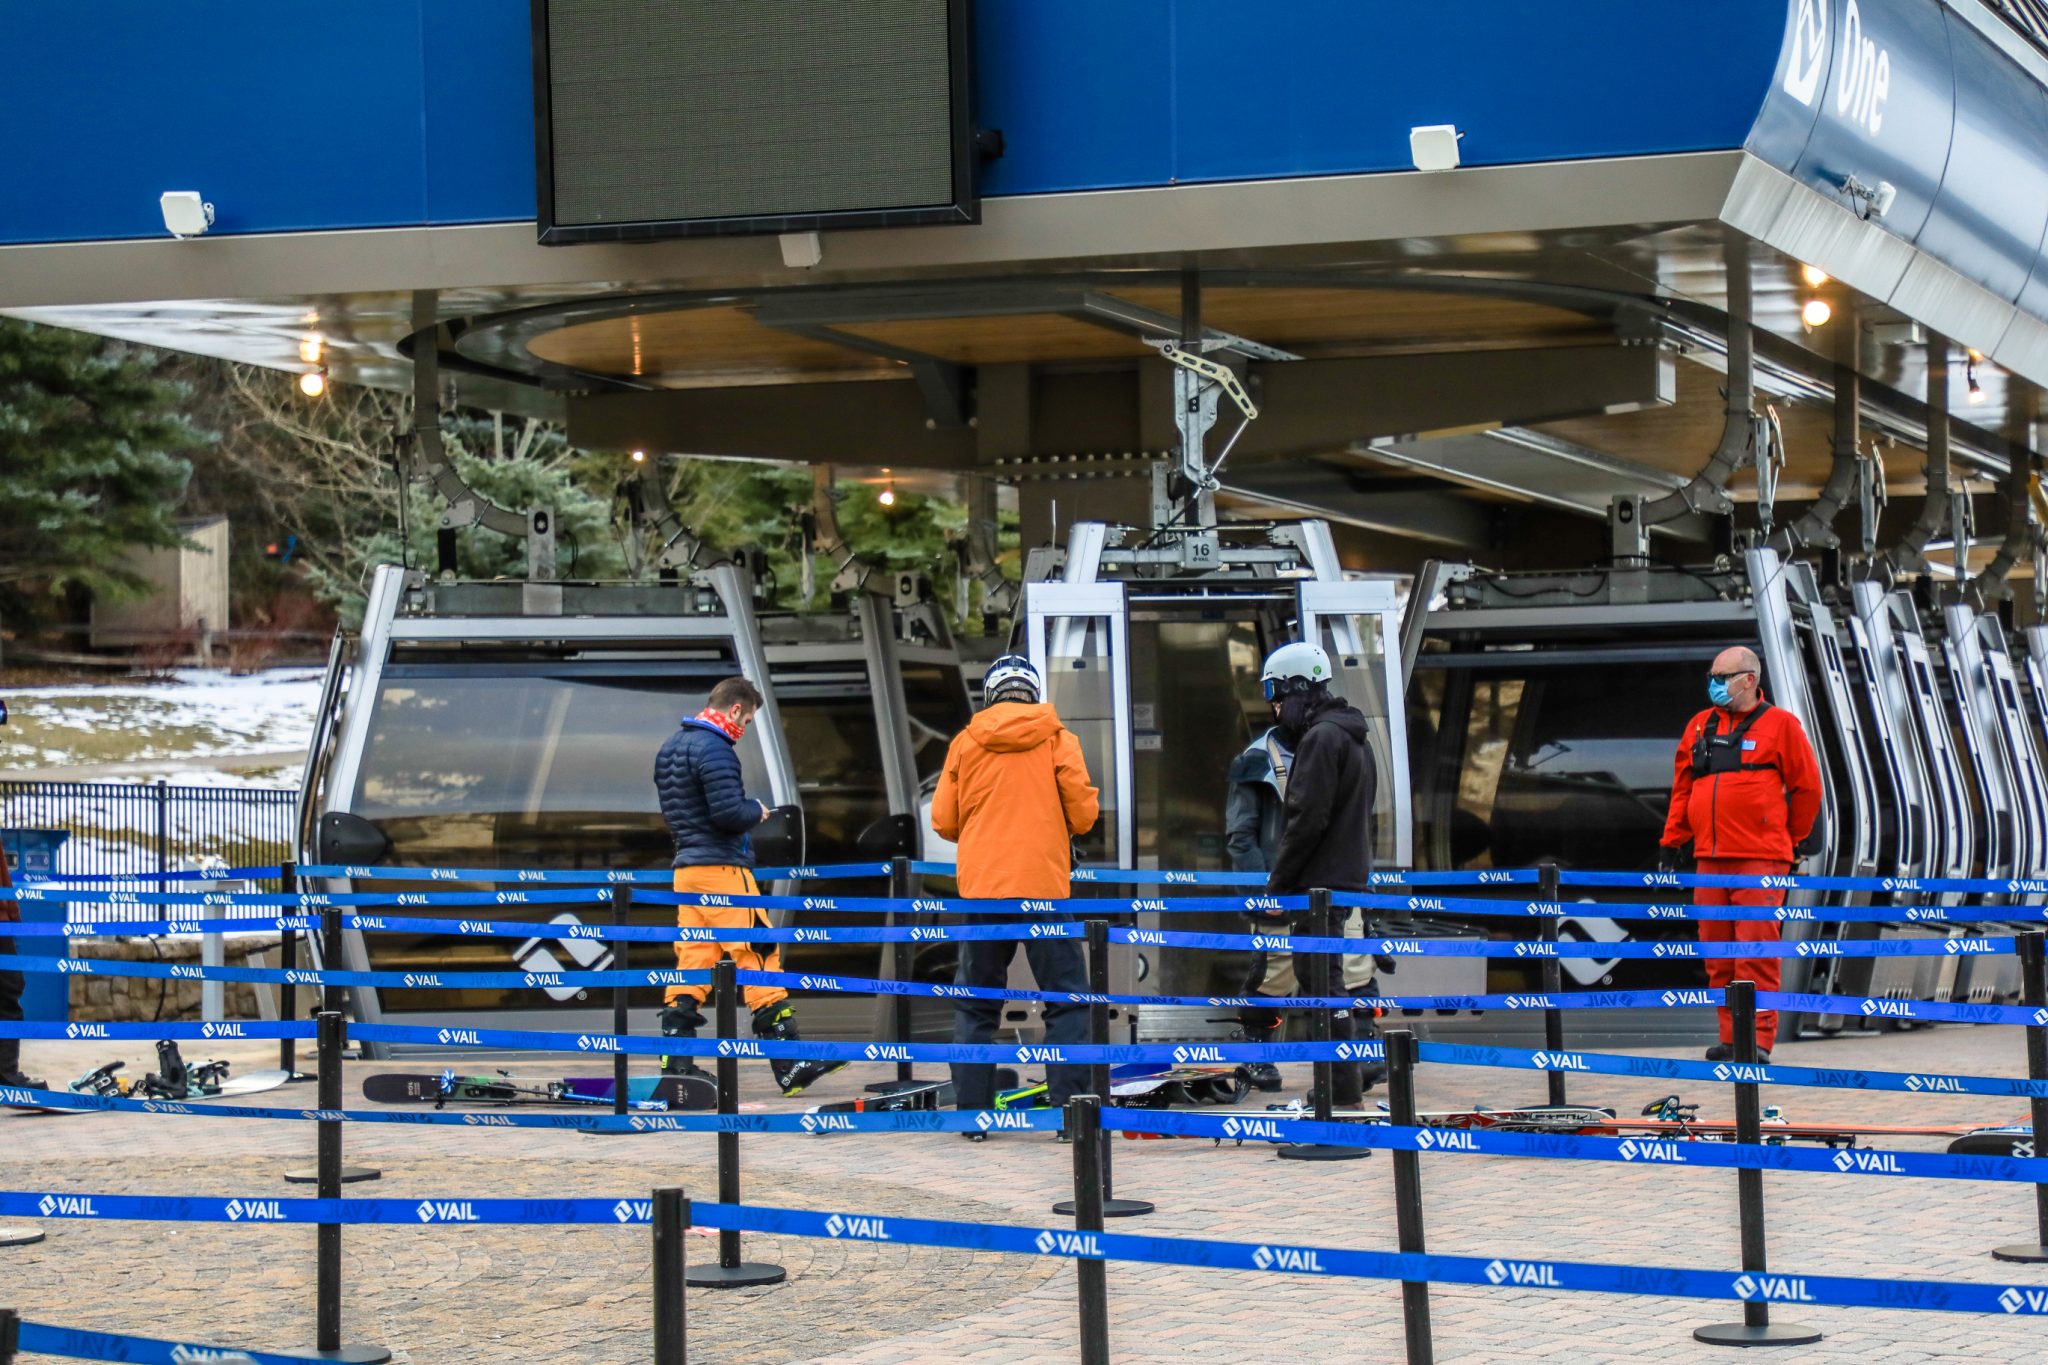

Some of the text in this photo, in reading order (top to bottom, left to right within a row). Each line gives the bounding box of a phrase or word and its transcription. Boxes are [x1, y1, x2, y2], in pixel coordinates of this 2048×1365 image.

[1837, 0, 1890, 136] One
[1193, 544, 1210, 556] 16
[354, 868, 371, 876] VAIL
[441, 870, 457, 878] VAIL
[526, 872, 545, 880] VAIL
[1073, 870, 1096, 879] VAIL
[1173, 873, 1196, 882] VAIL
[1490, 873, 1512, 881] VAIL
[1382, 874, 1404, 883] VAIL
[1655, 875, 1678, 884] VAIL
[1774, 876, 1796, 887] VAIL
[1895, 879, 1919, 889] VAIL
[2021, 881, 2047, 891] VAIL
[25, 890, 44, 899] VAIL
[119, 893, 138, 903] VAIL
[214, 895, 233, 905] VAIL
[311, 896, 330, 904] VAIL
[407, 895, 427, 903] VAIL
[504, 893, 527, 901] VAIL
[709, 895, 731, 905] VAIL
[815, 900, 835, 908] VAIL
[921, 901, 945, 910] VAIL
[1030, 902, 1054, 911] VAIL
[1143, 901, 1165, 910] VAIL
[1256, 899, 1280, 909] VAIL
[1420, 899, 1443, 909] VAIL
[1539, 905, 1564, 914] VAIL
[1661, 907, 1686, 917] VAIL
[1786, 909, 1813, 919] VAIL
[1918, 909, 1947, 919] VAIL
[179, 922, 201, 932] VAIL
[287, 918, 309, 928] VAIL
[363, 918, 384, 928] VAIL
[470, 923, 492, 933] VAIL
[73, 924, 94, 934] VAIL
[579, 928, 602, 938] VAIL
[691, 929, 714, 940] VAIL
[923, 929, 946, 938] VAIL
[1042, 926, 1068, 935] VAIL
[806, 930, 829, 940] VAIL
[1139, 932, 1166, 943] VAIL
[1265, 938, 1293, 948] VAIL
[1395, 942, 1423, 952] VAIL
[1811, 943, 1843, 954] VAIL
[1960, 939, 1992, 951] VAIL
[1528, 944, 1555, 954] VAIL
[1667, 945, 1695, 955] VAIL
[67, 961, 91, 972] VAIL
[180, 966, 206, 978] VAIL
[297, 971, 323, 983] VAIL
[413, 975, 441, 985] VAIL
[537, 974, 562, 985] VAIL
[660, 971, 685, 983] VAIL
[813, 978, 840, 989] VAIL
[943, 987, 973, 996] VAIL
[1517, 997, 1553, 1007] VAIL
[1676, 992, 1714, 1004] VAIL
[1878, 1002, 1914, 1016] VAIL
[77, 1025, 109, 1037] VAIL
[213, 1024, 246, 1036] VAIL
[450, 1031, 480, 1043] VAIL
[590, 1038, 622, 1050] VAIL
[730, 1042, 764, 1055] VAIL
[877, 1046, 911, 1059] VAIL
[1030, 1048, 1066, 1061] VAIL
[1190, 1047, 1223, 1060] VAIL
[1353, 1044, 1384, 1057] VAIL
[1550, 1053, 1587, 1070] VAIL
[1731, 1066, 1771, 1082] VAIL
[1922, 1078, 1965, 1092] VAIL
[7, 1090, 36, 1103] VAIL
[155, 1102, 192, 1114] VAIL
[318, 1110, 352, 1121] VAIL
[477, 1115, 515, 1126] VAIL
[992, 1113, 1033, 1128] VAIL
[643, 1117, 681, 1129] VAIL
[815, 1116, 855, 1129] VAIL
[1242, 1120, 1283, 1137] VAIL
[1436, 1133, 1479, 1149] VAIL
[1640, 1142, 1684, 1160] VAIL
[1856, 1154, 1904, 1172] VAIL
[55, 1198, 95, 1214] VAIL
[245, 1202, 284, 1218] VAIL
[437, 1203, 477, 1220] VAIL
[846, 1217, 889, 1239] VAIL
[1058, 1237, 1103, 1256] VAIL
[1275, 1249, 1322, 1271] VAIL
[1508, 1264, 1559, 1286] VAIL
[1760, 1277, 1812, 1299] VAIL
